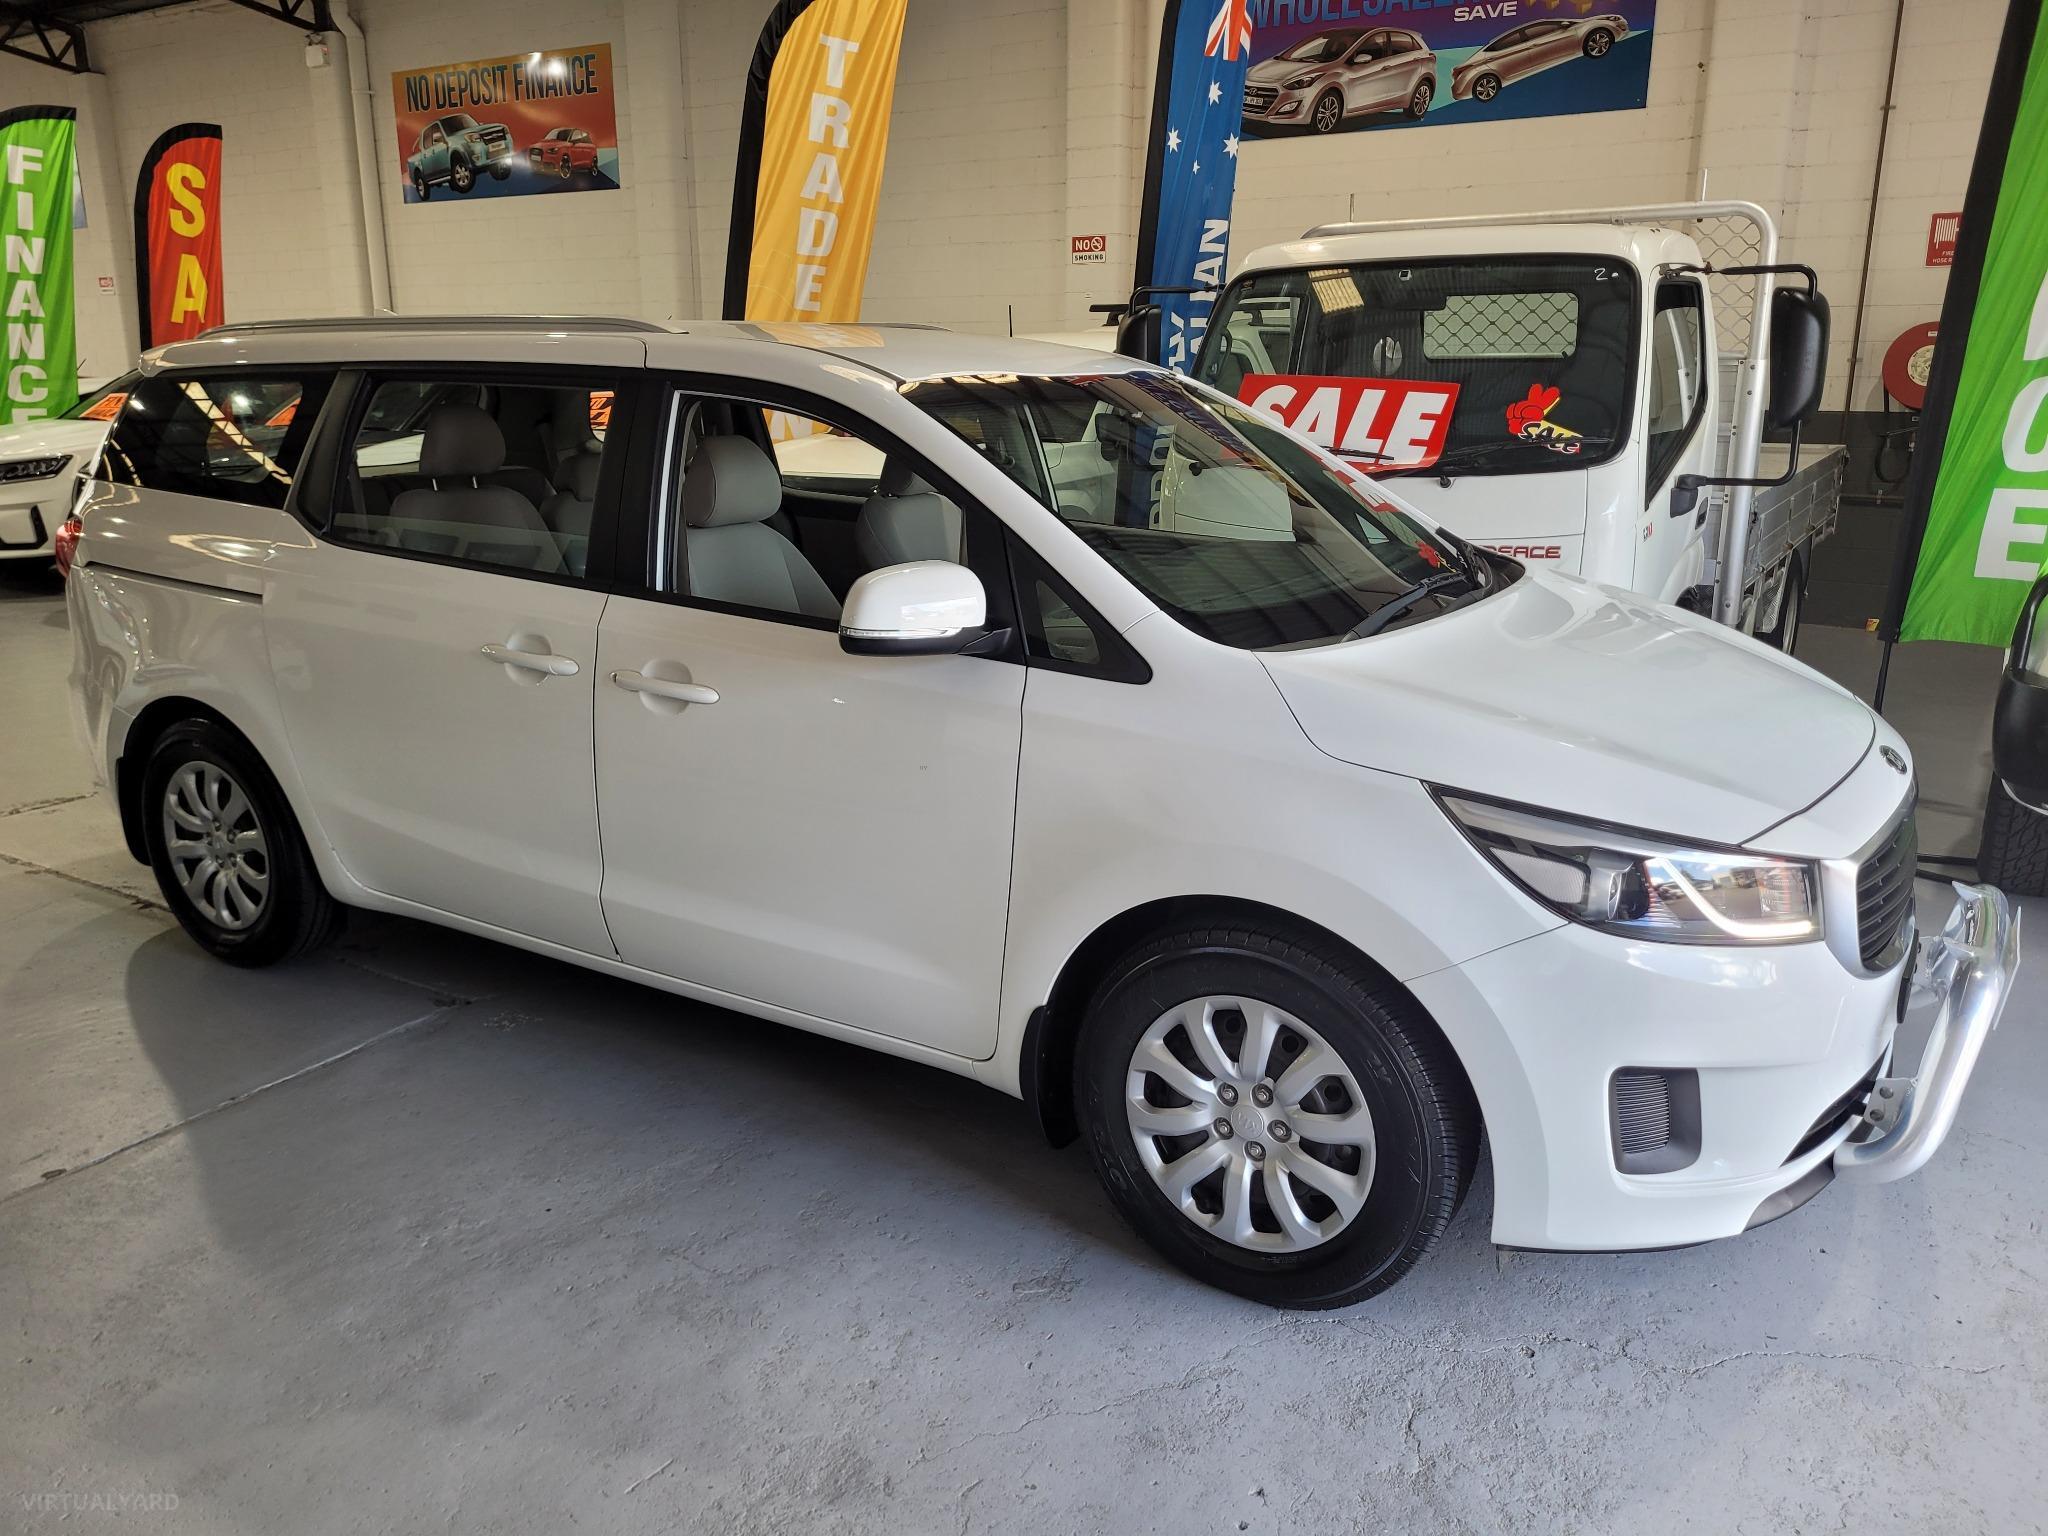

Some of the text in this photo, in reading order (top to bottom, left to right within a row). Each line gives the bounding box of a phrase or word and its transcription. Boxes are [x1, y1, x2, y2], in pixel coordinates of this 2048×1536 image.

[1454, 1, 1517, 22] SAVE
[405, 53, 599, 112] NO DEPOSIT FINANCE
[794, 33, 860, 312] TRADE
[1075, 239, 1090, 251] NO
[1250, 384, 1450, 465] SALE
